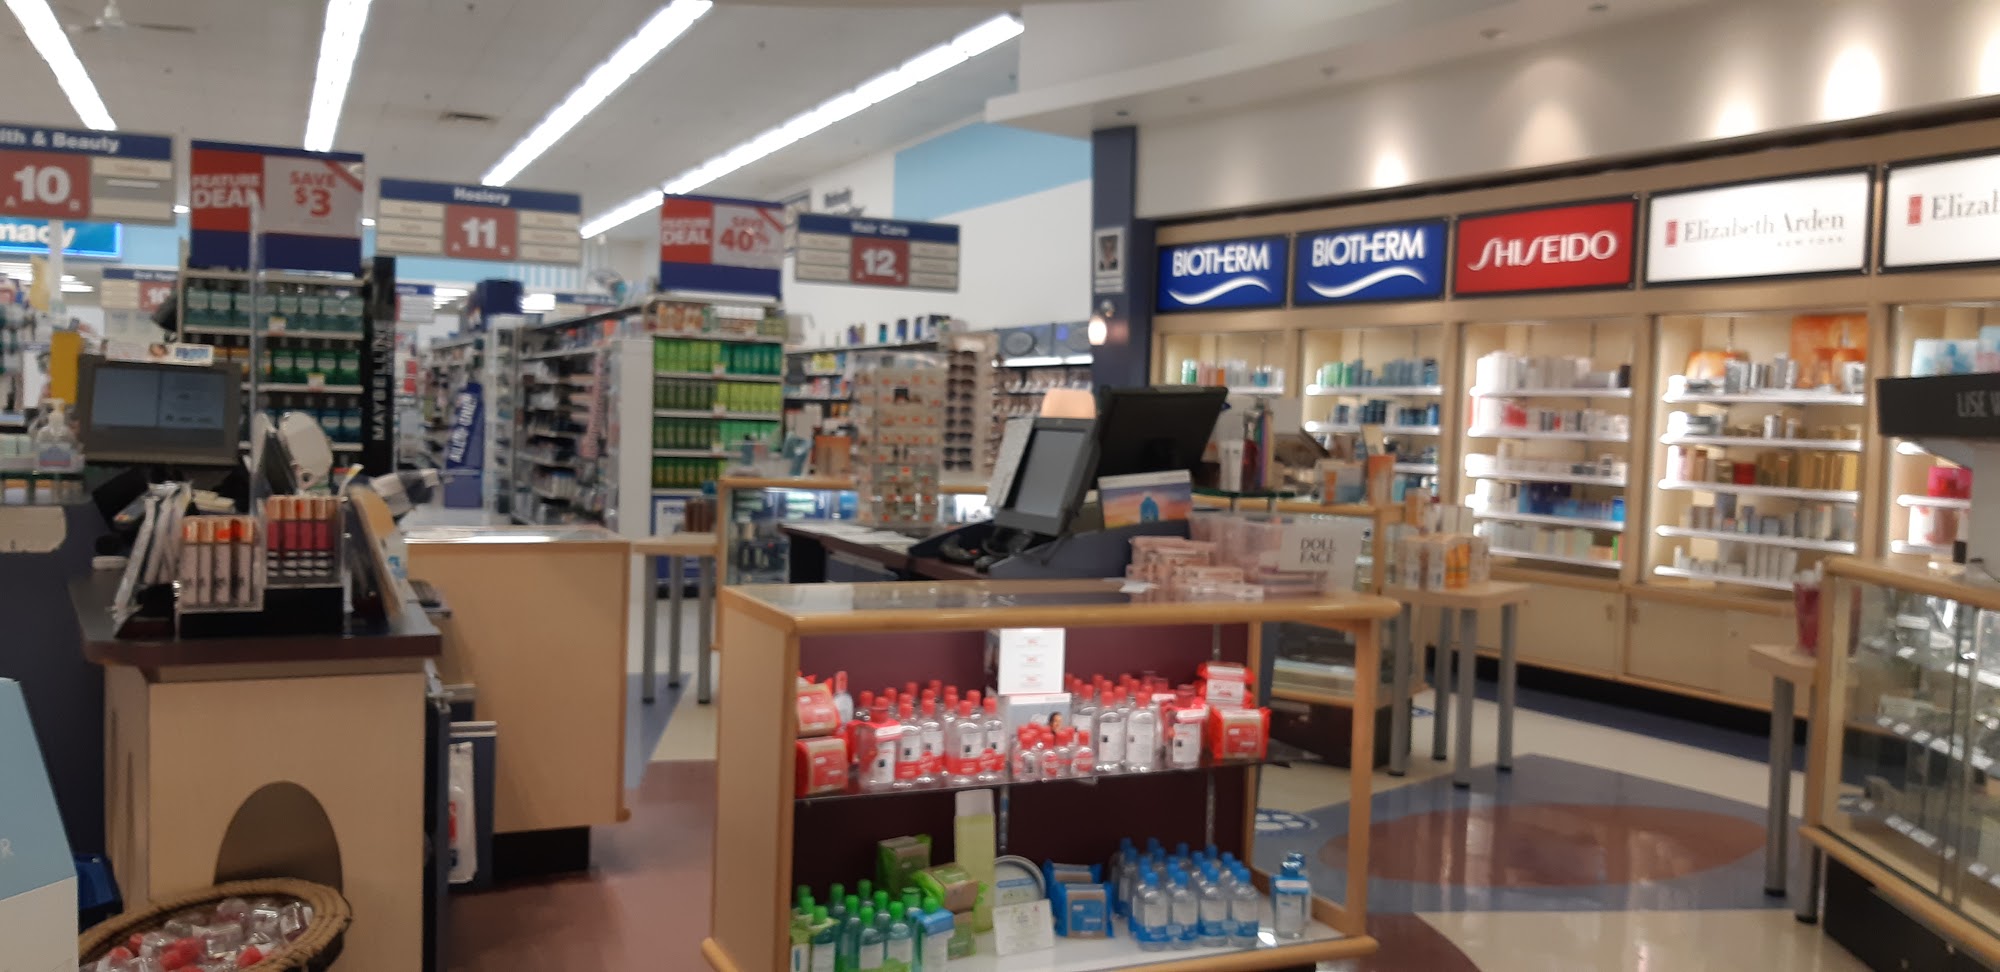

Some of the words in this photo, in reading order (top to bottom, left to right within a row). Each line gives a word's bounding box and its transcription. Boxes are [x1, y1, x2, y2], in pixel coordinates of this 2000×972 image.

[52, 132, 120, 153] Beauty
[13, 165, 71, 205] 10
[192, 173, 260, 188] FEATURE
[290, 171, 337, 188] SAVE
[461, 216, 497, 249] 11
[662, 229, 711, 246] DEAL
[1684, 214, 1775, 242] Elizabeth
[1783, 207, 1845, 233] Arden
[1172, 243, 1270, 277] BIOTHERM
[1312, 228, 1426, 267] BIOTHERM
[1467, 230, 1617, 271] SHISEIDO
[861, 248, 896, 277] 12
[1299, 551, 1334, 565] FACE
[1300, 537, 1336, 551] DOLL
